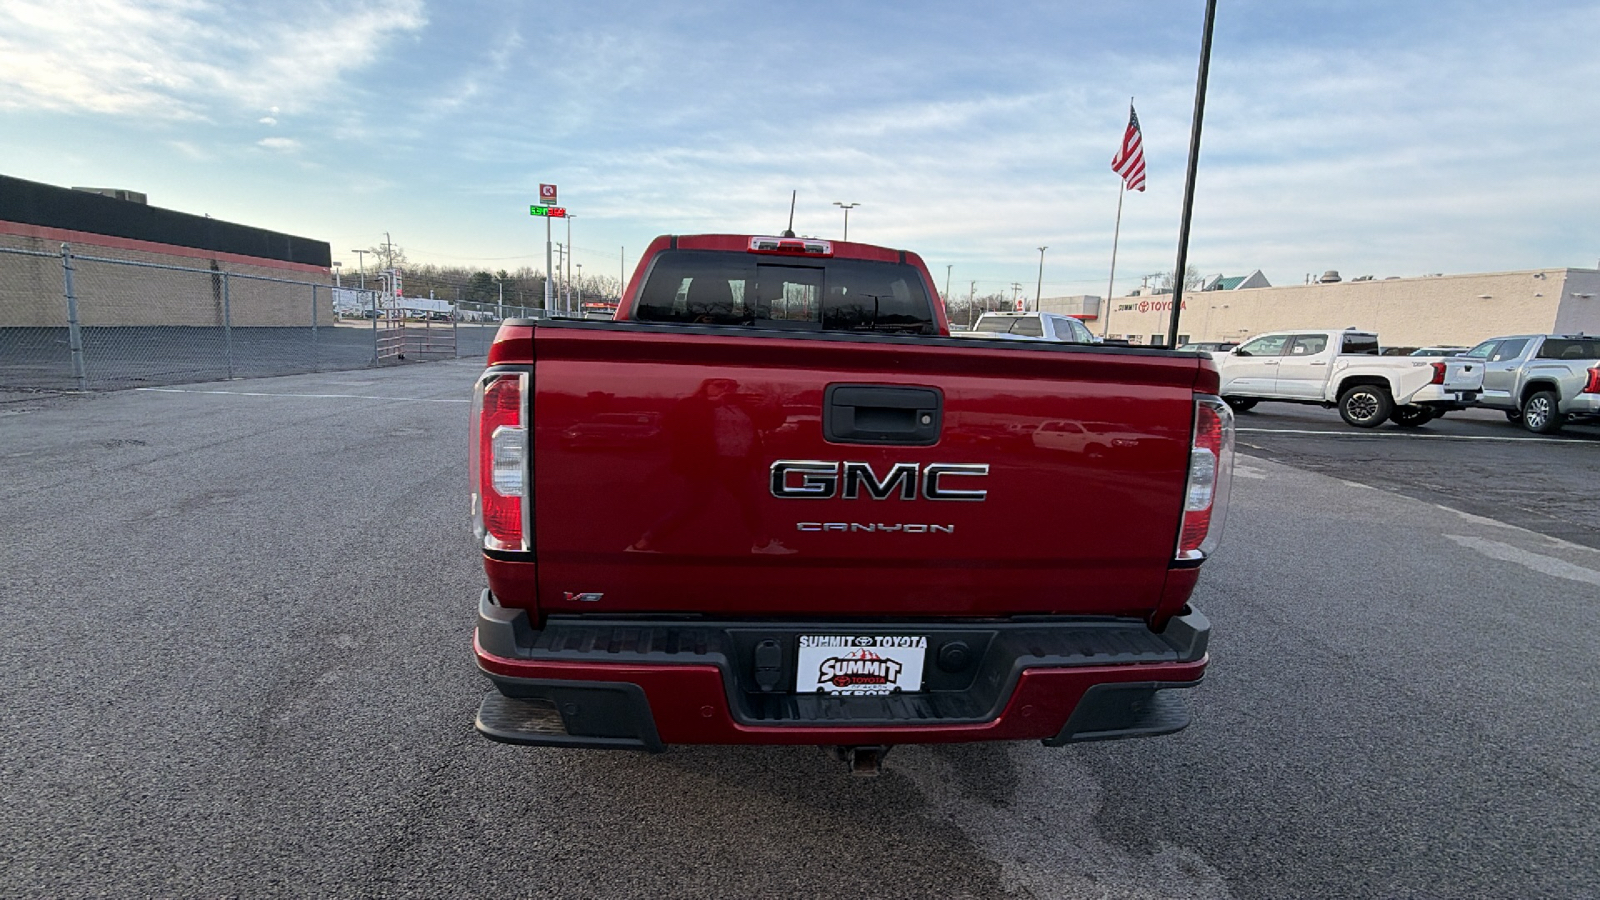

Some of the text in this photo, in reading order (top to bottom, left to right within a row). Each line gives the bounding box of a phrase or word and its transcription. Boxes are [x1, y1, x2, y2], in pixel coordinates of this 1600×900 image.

[1151, 300, 1187, 311] TOYOA
[770, 459, 990, 501] GMC
[796, 522, 954, 534] CANYON
[563, 591, 604, 602] V6
[799, 635, 928, 649] SUMMIT TOYOTA
[819, 659, 901, 683] SUMMIT
